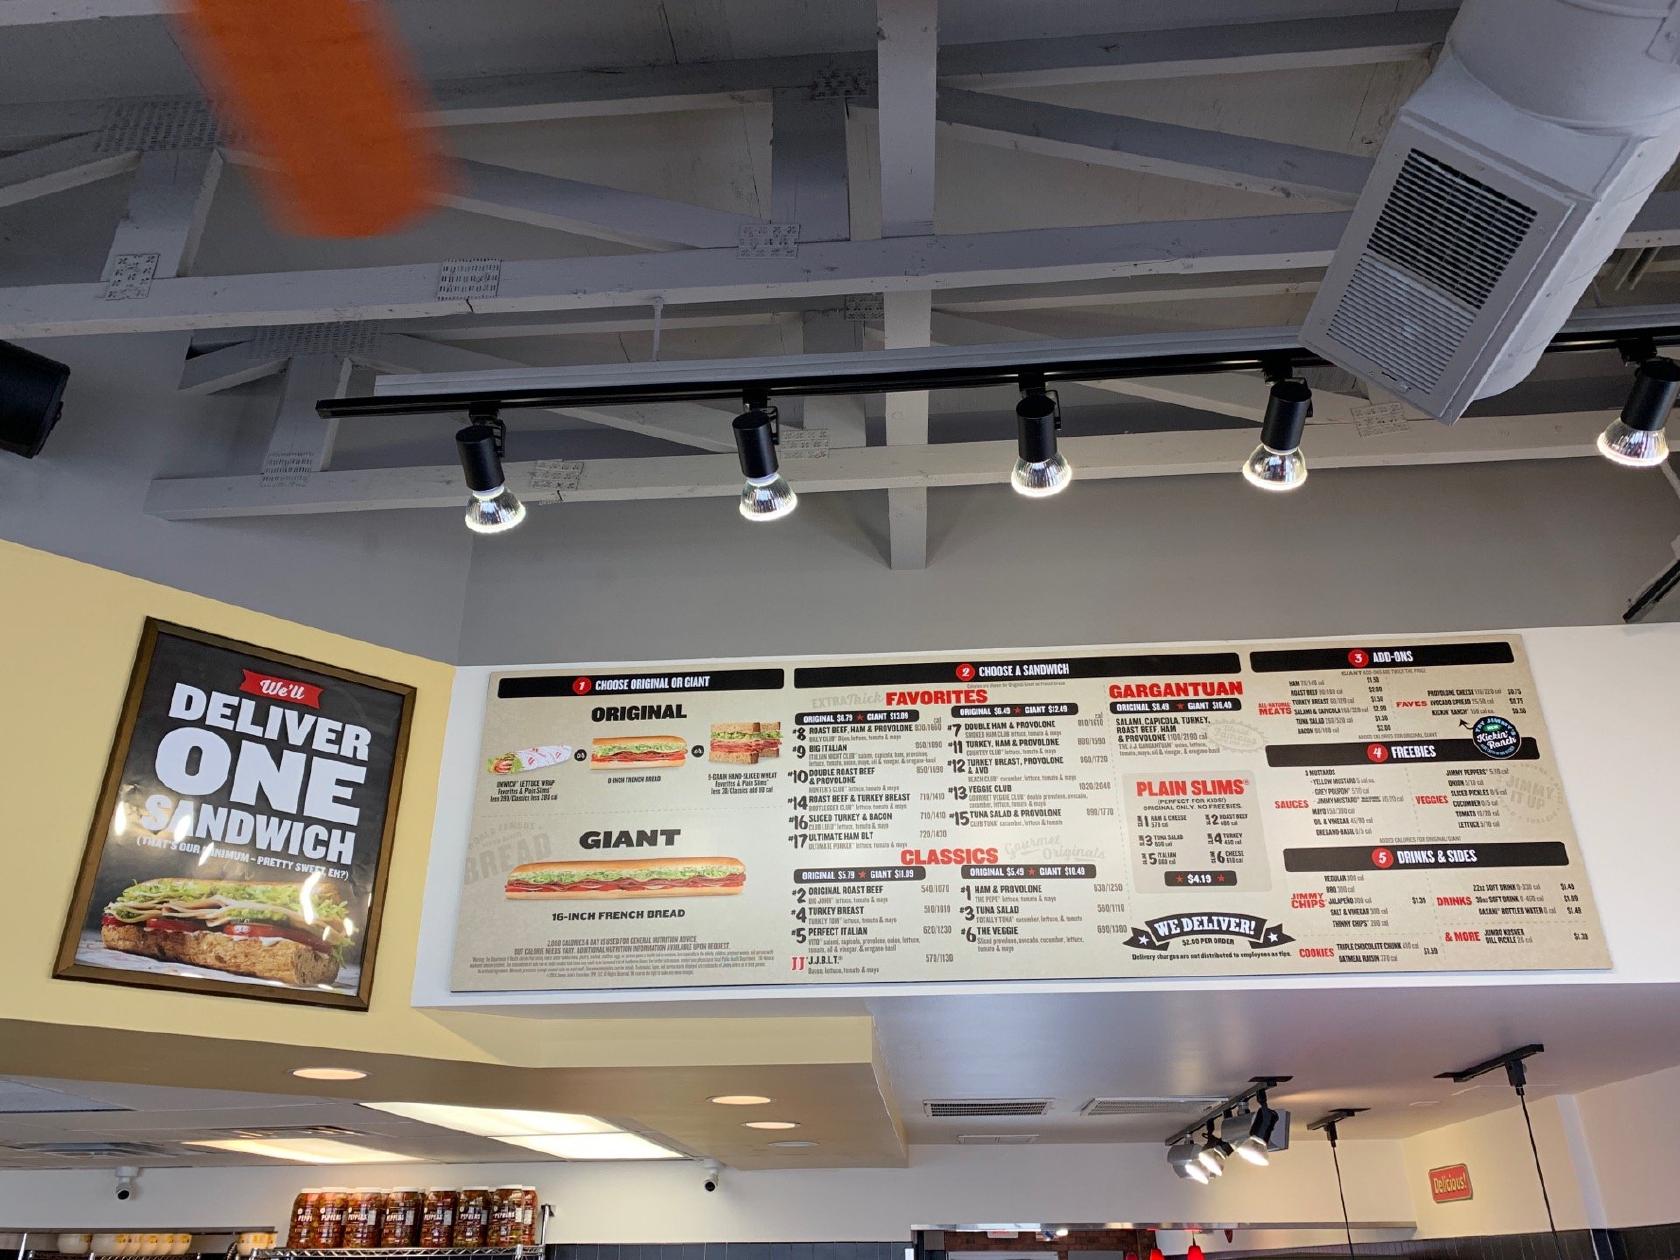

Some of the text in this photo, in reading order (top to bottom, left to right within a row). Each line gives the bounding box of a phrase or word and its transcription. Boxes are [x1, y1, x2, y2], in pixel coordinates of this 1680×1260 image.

[1354, 650, 1414, 663] 3 ADD-ONS
[961, 663, 1070, 677] 2 CHOOSE A SANDWICH
[259, 679, 305, 701] We'll
[578, 675, 710, 691] 1 CHOOSE ORIGINAL OR GIANT
[1108, 680, 1244, 699] GARGANTUAN
[811, 695, 847, 710] EXTRA
[885, 688, 989, 707] FAVORITES
[1395, 700, 1428, 708] FAVES
[591, 704, 687, 722] ORIGINAL
[959, 708, 992, 716] ORIGINAL
[1024, 706, 1046, 714] GIANT
[1116, 703, 1150, 712] ORIGINAL
[1187, 702, 1209, 710] GIANT
[1259, 707, 1292, 716] MEATS
[168, 682, 372, 761] DELIVER
[947, 723, 962, 737] #7
[965, 722, 990, 731] DOUBLE
[991, 722, 1008, 730] HAM
[1009, 721, 1015, 729] &
[1016, 720, 1056, 729] PROVOLONE
[1117, 726, 1140, 734] ROAST
[1161, 725, 1177, 733] HAM
[792, 727, 807, 741] #8
[809, 726, 831, 735] ROAST
[850, 725, 866, 733] HAM
[867, 724, 873, 733] &
[874, 723, 913, 733] PROVOLONE
[1476, 731, 1509, 744] Kickin'
[947, 740, 963, 754] #11
[995, 739, 1011, 747] HAM
[1012, 739, 1018, 747] &
[1019, 738, 1060, 746] PROVOLONE
[1487, 735, 1517, 750] Ranch
[792, 744, 847, 759] #9 BIG ITALIAN
[1372, 745, 1437, 759] 4 FREEBIES
[947, 758, 966, 773] #12
[967, 758, 992, 767] TURKEY
[1023, 756, 1064, 765] PROVOLONE
[154, 726, 367, 826] ONE
[787, 767, 875, 784] #10 DOUBLE ROAST BEEF
[809, 776, 856, 785] & PROVOLONE
[948, 784, 1012, 800] #13 VEGGIE CLUB
[1136, 780, 1188, 797] PLAIN
[787, 795, 808, 811] #14
[809, 795, 831, 804] ROAST
[832, 795, 849, 803] BEEF
[850, 794, 856, 802] &
[857, 793, 883, 802] TURKEY
[885, 793, 911, 802] BREAST
[1275, 800, 1309, 809] SAUCES
[1415, 795, 1449, 805] VEGGIES
[788, 815, 808, 830] #16
[809, 814, 833, 822] SLICED
[834, 813, 860, 822] TURKEY
[862, 813, 868, 821] &
[869, 812, 893, 821] BACON
[949, 811, 970, 826] #15
[970, 810, 989, 818] TUNA
[990, 809, 1012, 818] SALAD
[1013, 809, 1019, 817] &
[1020, 809, 1062, 817] PROVOLONE
[142, 795, 356, 865] SANDWICH
[579, 829, 681, 850] GIANT
[787, 834, 808, 849] #17
[809, 832, 843, 841] ULTIMATE
[844, 832, 860, 840] HAM
[862, 831, 874, 840] BLT
[178, 842, 200, 854] OUR
[257, 856, 294, 870] PRETTY
[327, 867, 349, 882] EH?)
[901, 847, 999, 866] CLASSICS
[1378, 849, 1478, 865] 5 DRINKS & SIDES
[802, 871, 836, 880] ORIGINAL
[870, 870, 892, 879] GIANT
[969, 868, 1005, 876] ORIGINAL
[1039, 867, 1061, 875] GIANT
[1187, 874, 1213, 885] $4.19
[791, 886, 884, 904] #2 ORIGINAL ROAST BEEF
[960, 884, 1042, 901] #1 HAM & PROVOLONE
[1290, 892, 1325, 900] JIMMY
[1291, 899, 1326, 909] CHIPS
[1436, 896, 1473, 906] DRINKS
[551, 908, 685, 921] 16-INCH FRENCH BREAD
[791, 906, 864, 923] #4 TURKEY BREAST
[960, 905, 1019, 921] #3 TUNA SALAD
[1154, 915, 1256, 937] WE DELIVER!
[791, 927, 868, 944] #5 PERFECT ITALIAN
[1214, 937, 1235, 945] ORDER
[1444, 930, 1481, 942] & MORE
[1298, 948, 1335, 958] COOKIES
[1354, 942, 1383, 951] CHOCOLATE
[1383, 941, 1402, 950] CHUNK
[1241, 951, 1271, 959] employees
[1433, 1170, 1467, 1194] Delicious!
